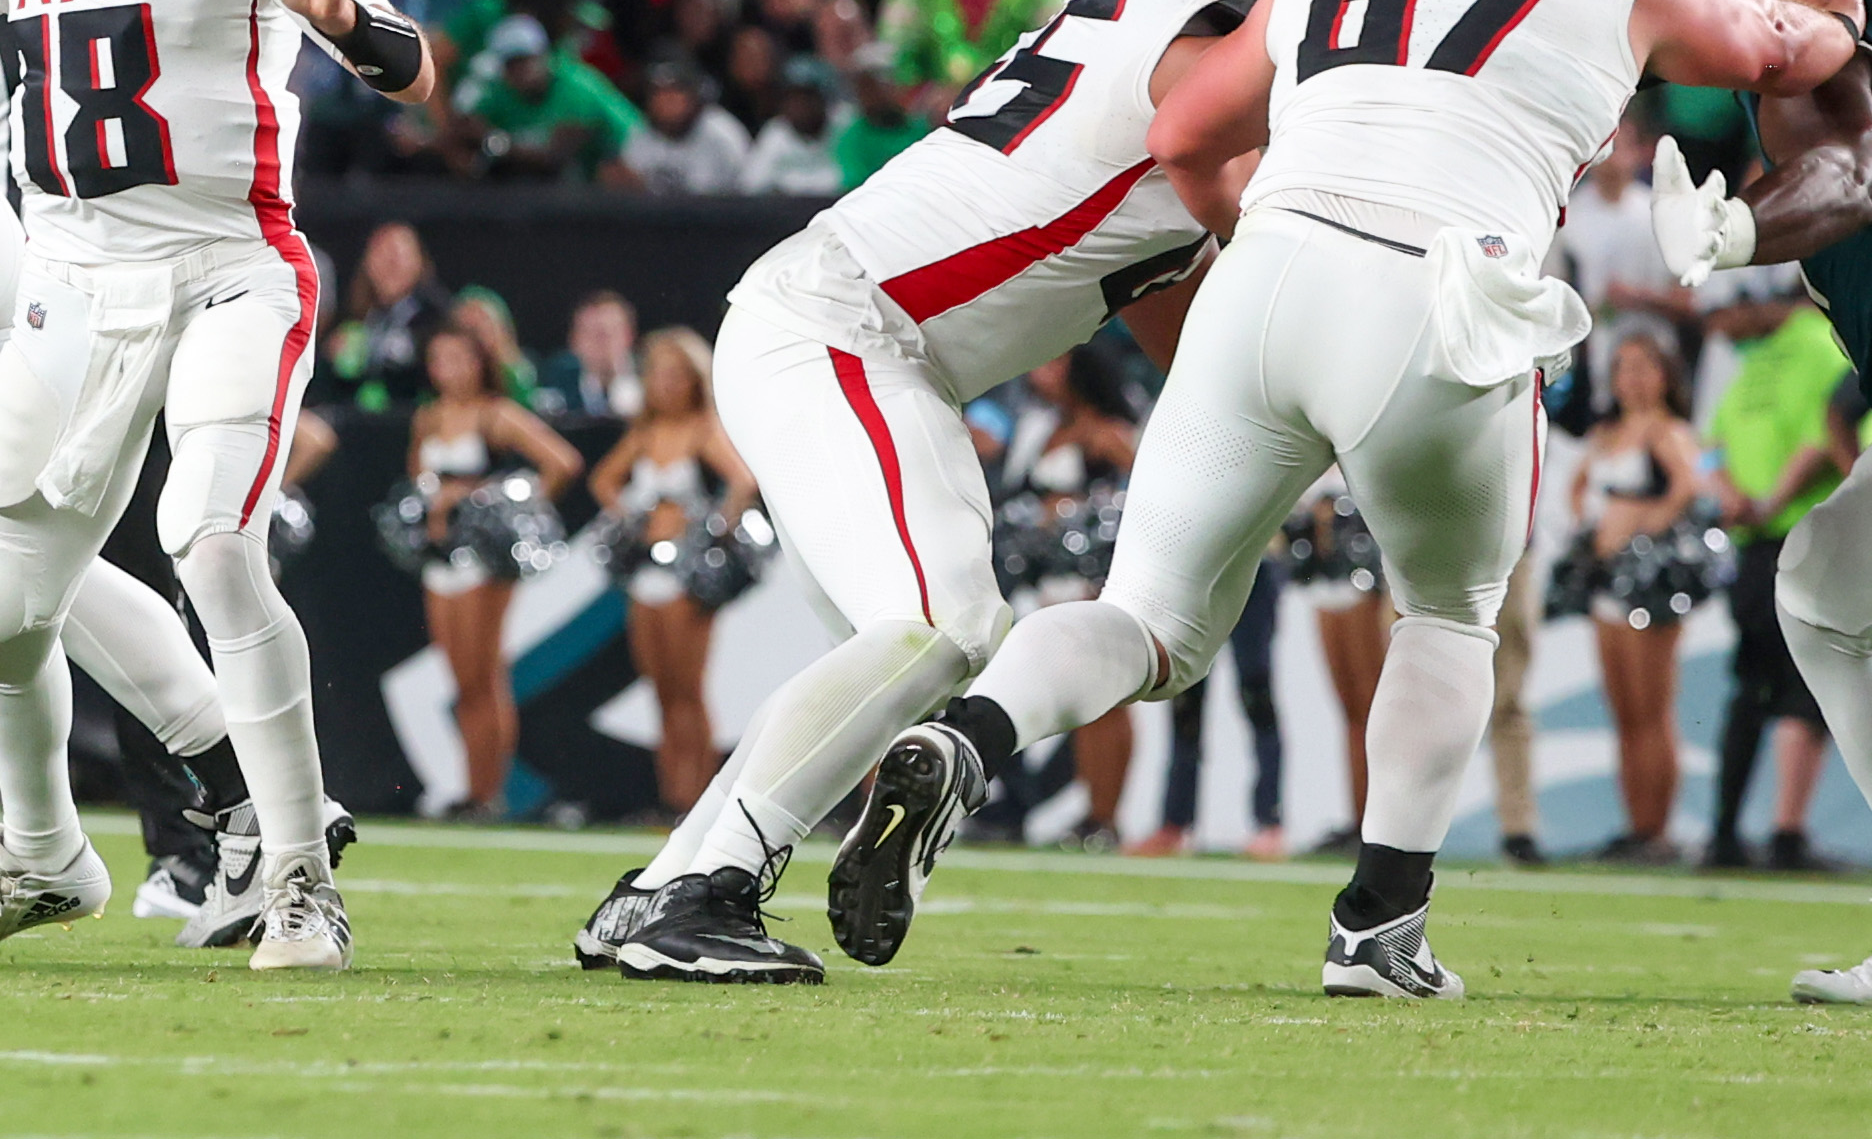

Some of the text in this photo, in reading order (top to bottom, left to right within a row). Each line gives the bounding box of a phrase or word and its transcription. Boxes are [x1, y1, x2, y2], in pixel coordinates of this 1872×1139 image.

[16, 2, 179, 200] 18
[1484, 245, 1507, 257] NFL
[1389, 968, 1418, 992] FORCE
